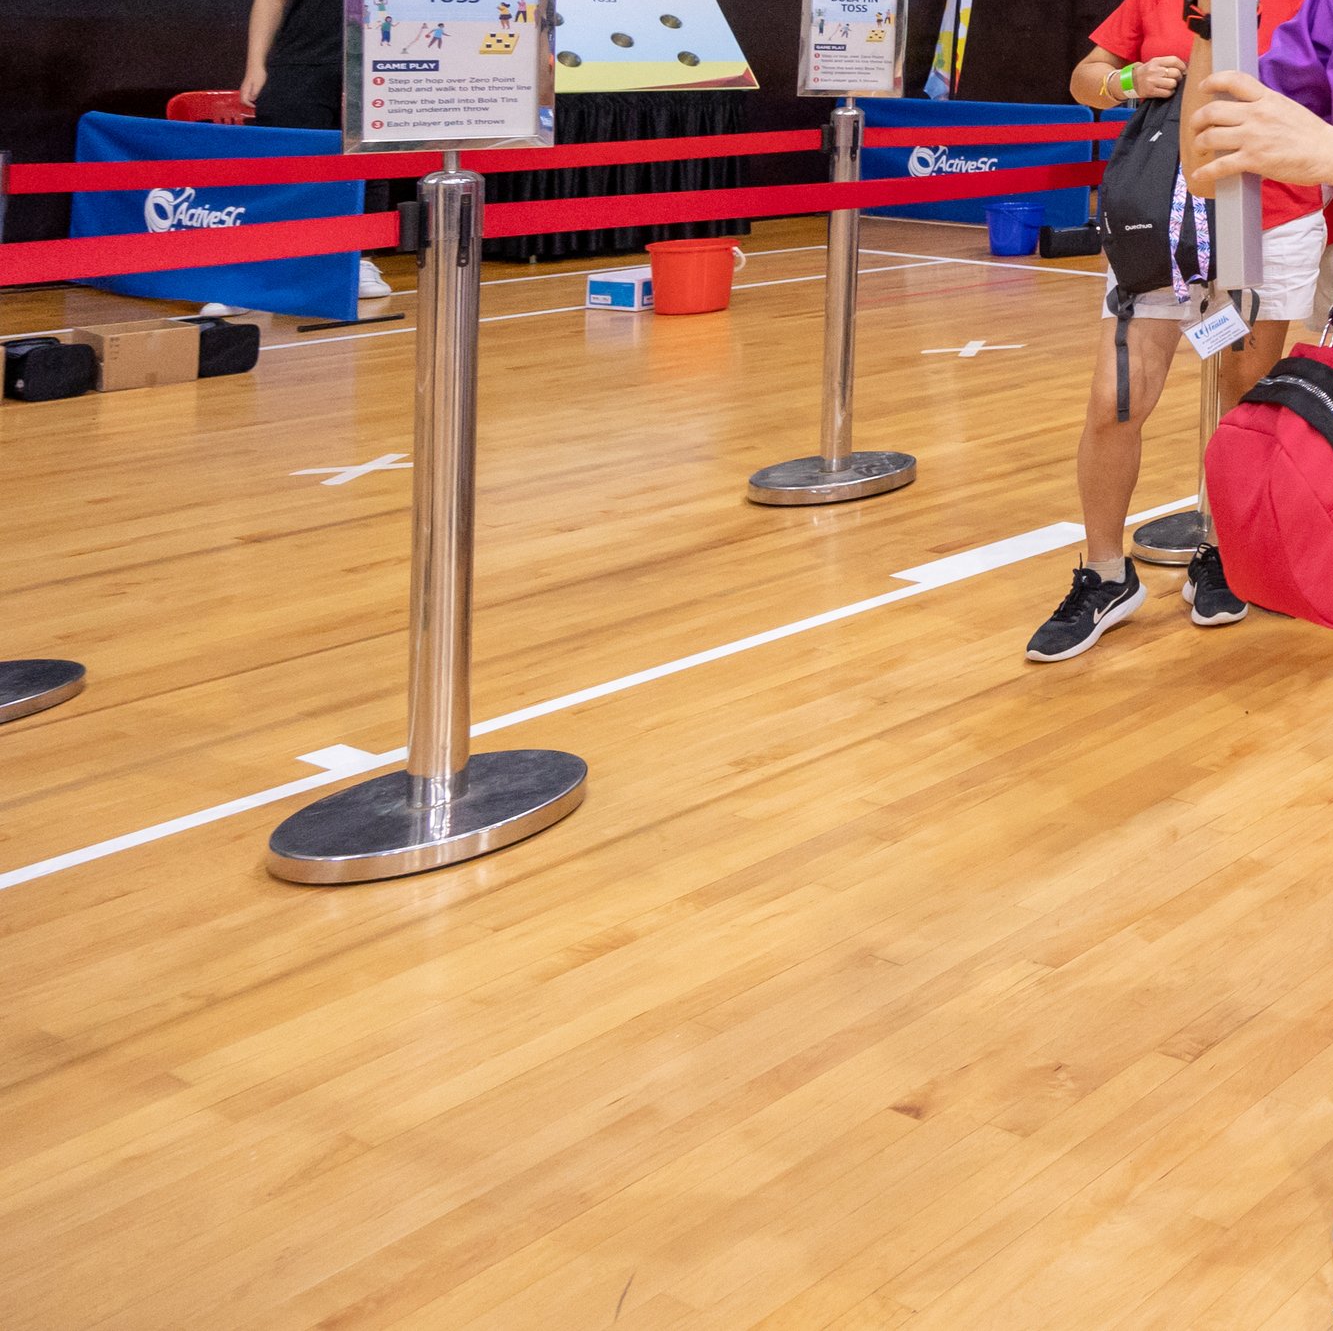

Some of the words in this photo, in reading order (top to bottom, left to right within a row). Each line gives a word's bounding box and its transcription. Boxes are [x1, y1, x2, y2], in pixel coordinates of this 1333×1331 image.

[841, 3, 868, 13] TOSS
[934, 154, 998, 173] ActiveSG
[172, 201, 246, 228] ActiveSG
[1125, 223, 1153, 231] Quechua
